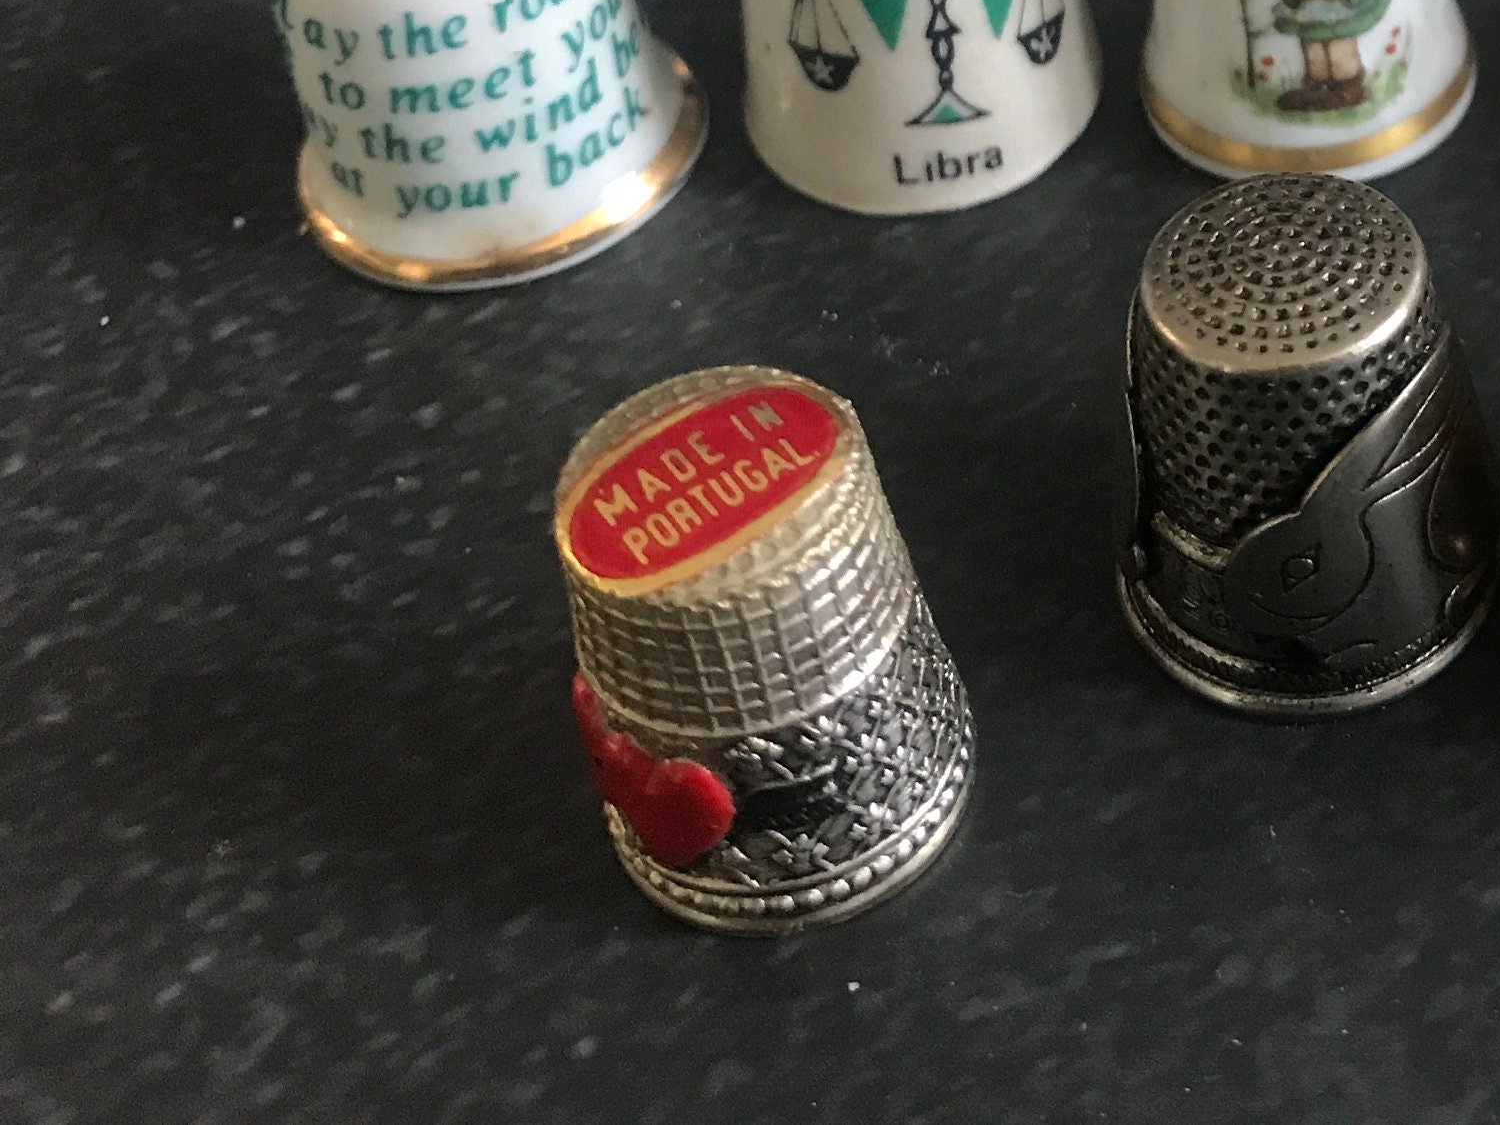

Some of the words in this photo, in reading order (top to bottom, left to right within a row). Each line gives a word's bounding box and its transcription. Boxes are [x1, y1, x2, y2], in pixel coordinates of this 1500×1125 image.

[317, 71, 367, 111] to
[389, 48, 537, 115] meet
[377, 12, 468, 60] the
[358, 121, 447, 165] the
[473, 56, 605, 154] wind
[395, 170, 521, 220] your
[543, 86, 647, 189] back
[893, 144, 1004, 185] Libra
[593, 429, 726, 527] MADE
[729, 400, 785, 442] IN
[621, 437, 816, 566] PORTUGAL
